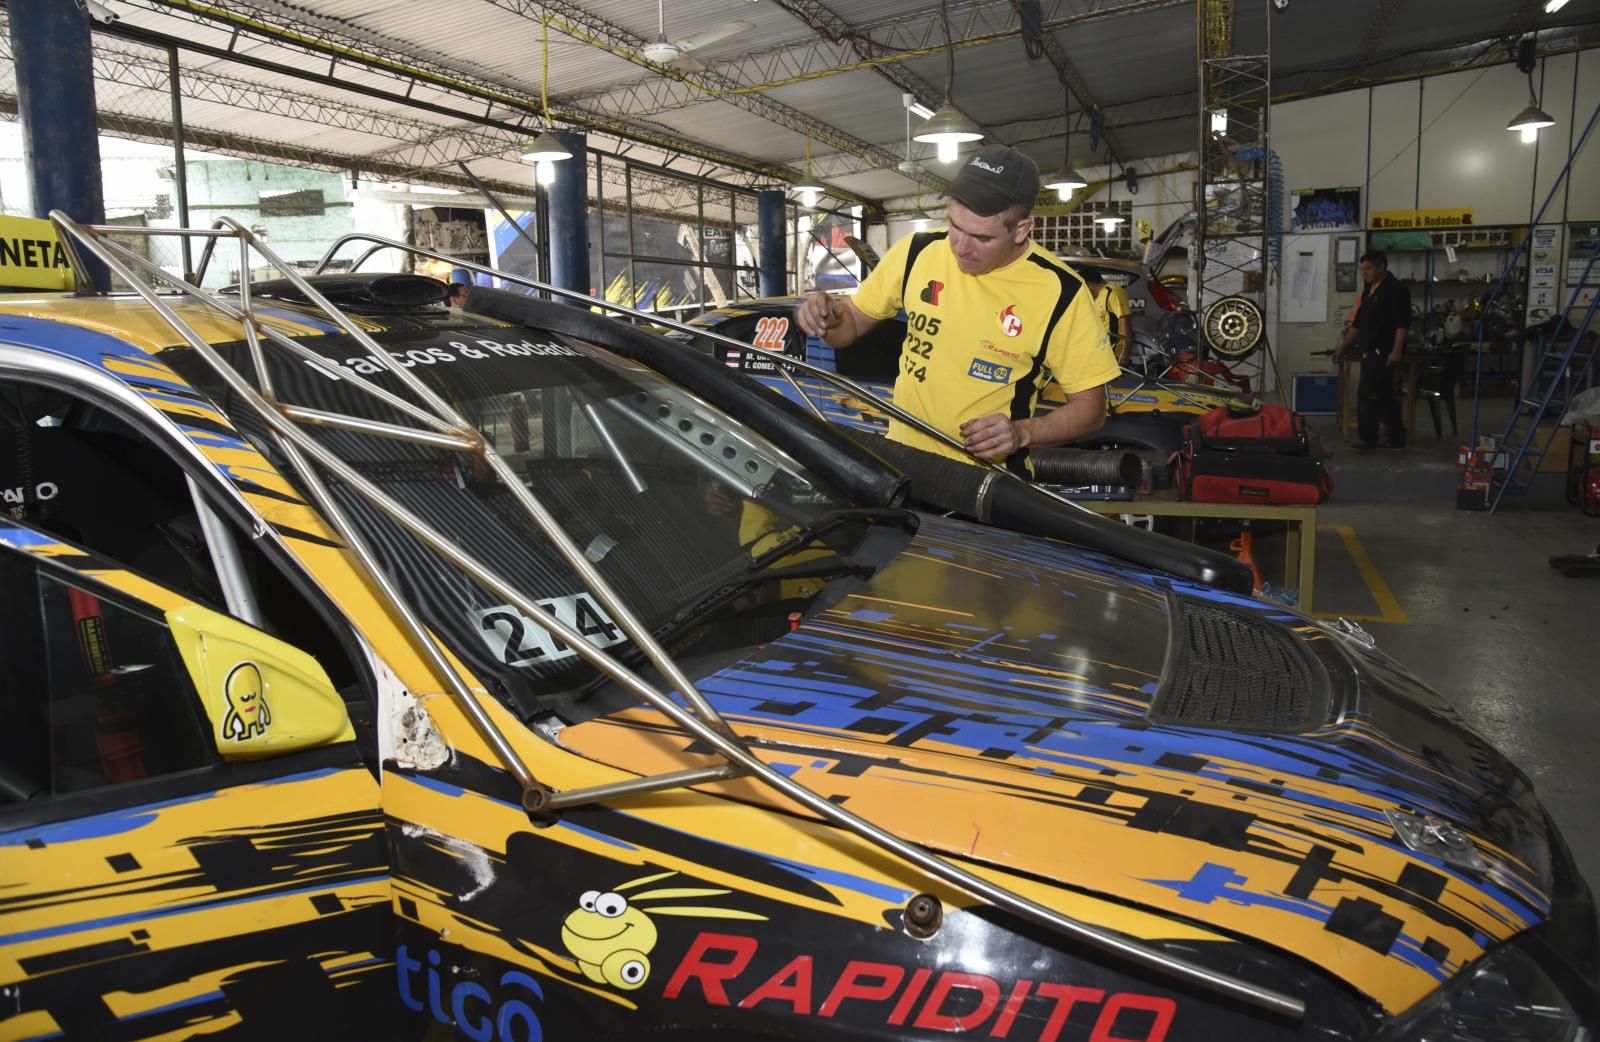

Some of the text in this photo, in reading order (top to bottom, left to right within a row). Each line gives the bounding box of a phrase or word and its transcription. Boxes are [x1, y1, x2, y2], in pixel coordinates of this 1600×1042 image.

[1384, 215, 1461, 227] Barcos & Rodados
[0, 237, 71, 269] NETA
[1536, 266, 1554, 274] VISA
[753, 317, 789, 351] 222
[449, 341, 490, 359] &
[476, 339, 585, 358] Rodad
[752, 362, 775, 370] GOMEZ
[904, 355, 927, 383] 74
[972, 362, 993, 374] FULL
[662, 932, 1177, 1042] RAPIDITO
